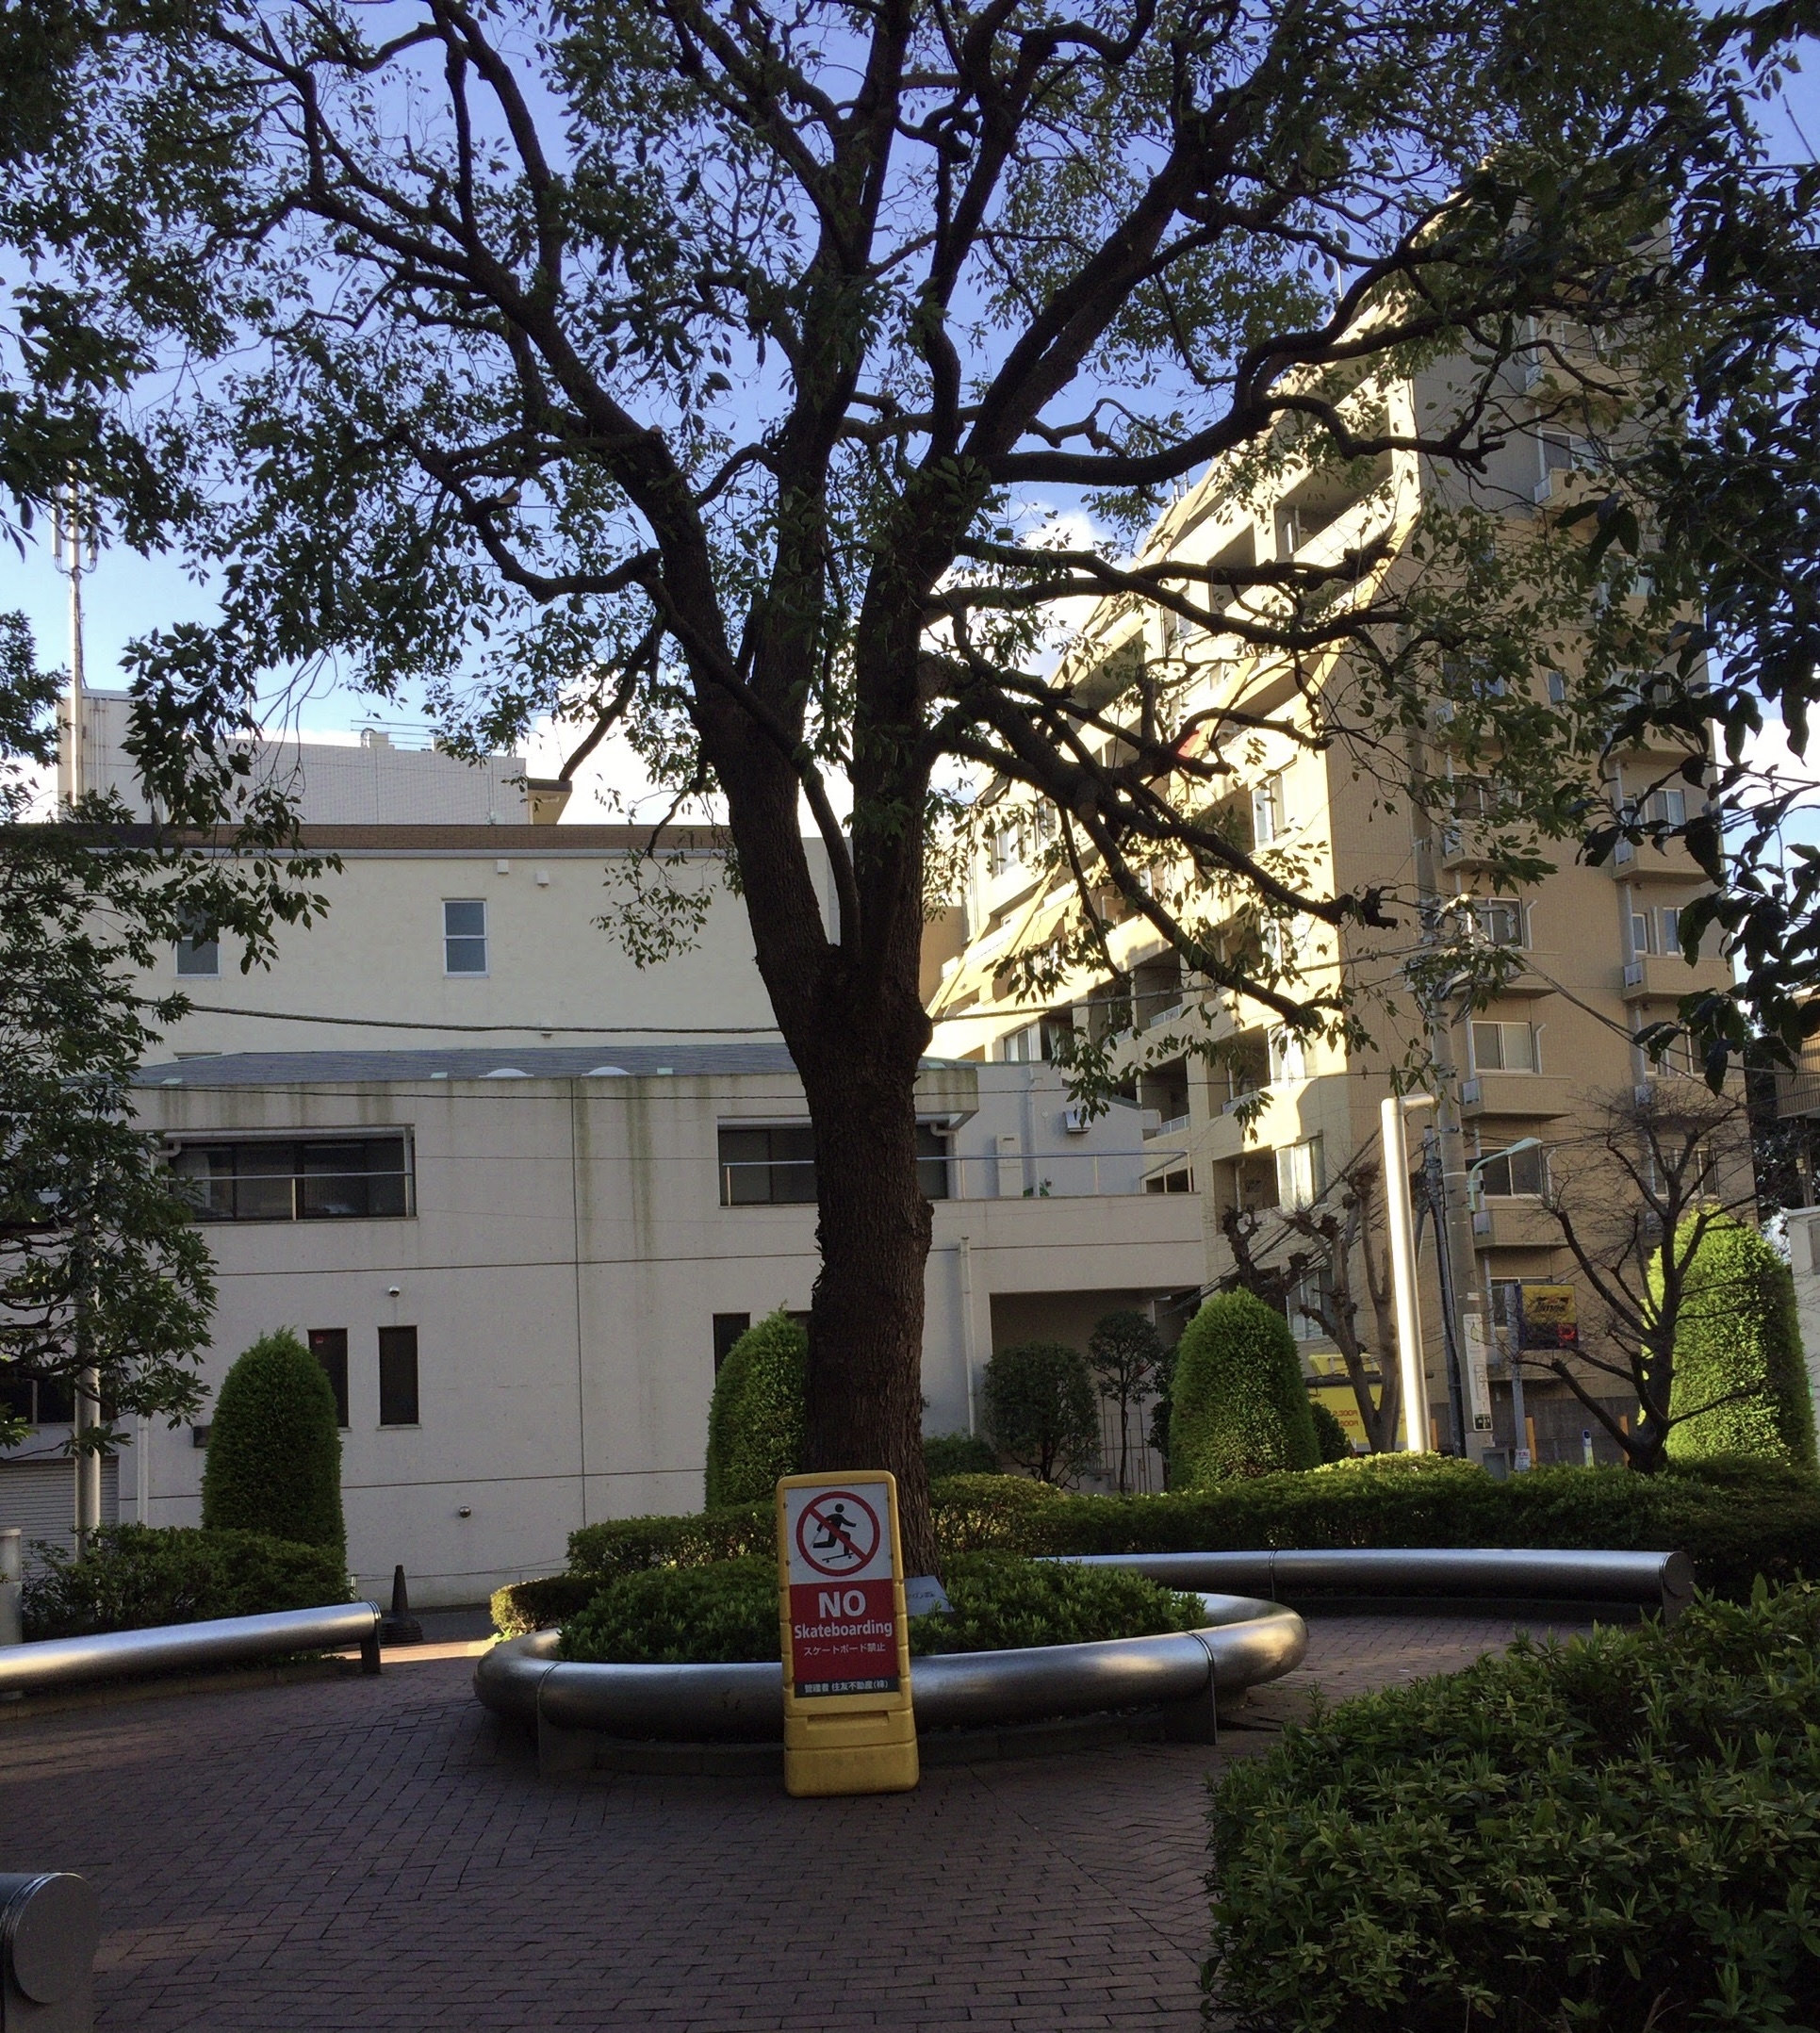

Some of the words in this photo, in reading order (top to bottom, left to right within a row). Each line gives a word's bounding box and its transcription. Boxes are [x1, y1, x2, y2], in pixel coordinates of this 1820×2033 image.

[818, 1589, 866, 1618] NO
[794, 1619, 893, 1638] Skateboarding
[803, 1642, 886, 1656] スケートボード禁止
